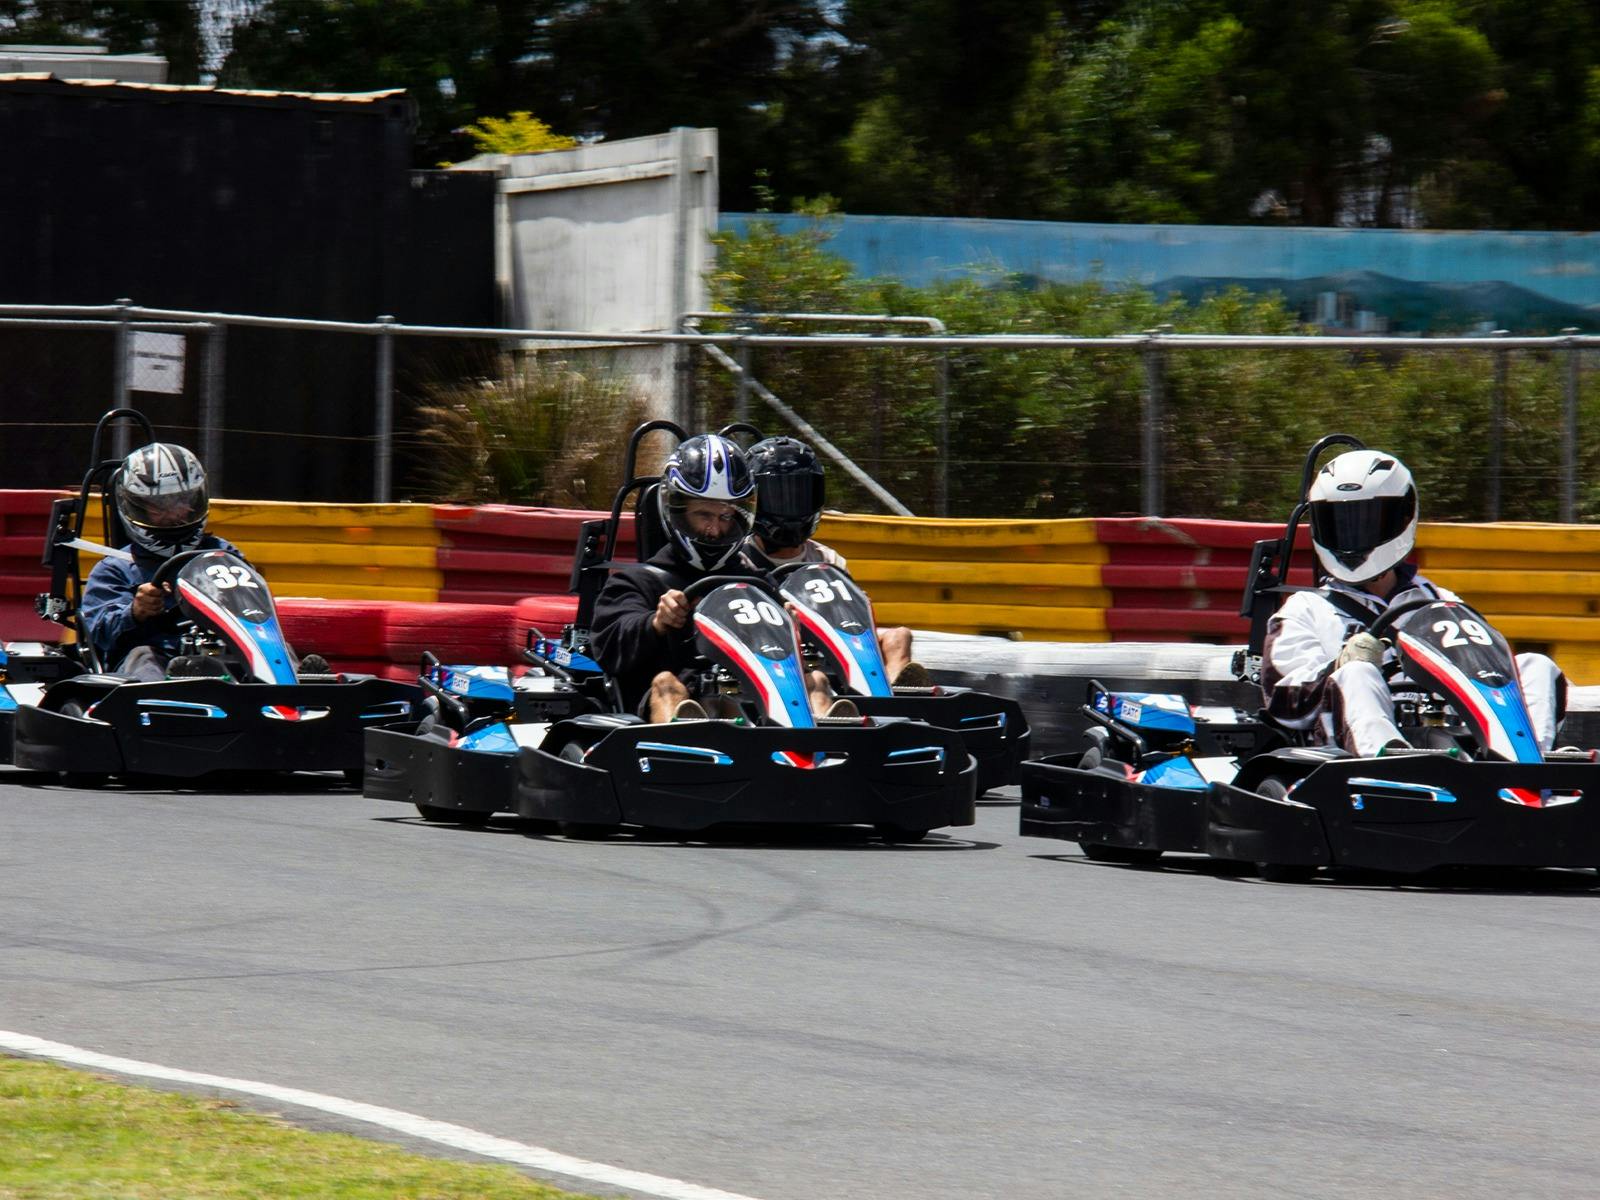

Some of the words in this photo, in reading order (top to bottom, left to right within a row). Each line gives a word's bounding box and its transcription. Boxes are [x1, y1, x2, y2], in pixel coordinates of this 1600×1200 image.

[205, 564, 259, 589] 32
[804, 578, 853, 603] 31
[727, 598, 784, 626] 30
[1431, 619, 1493, 648] 29
